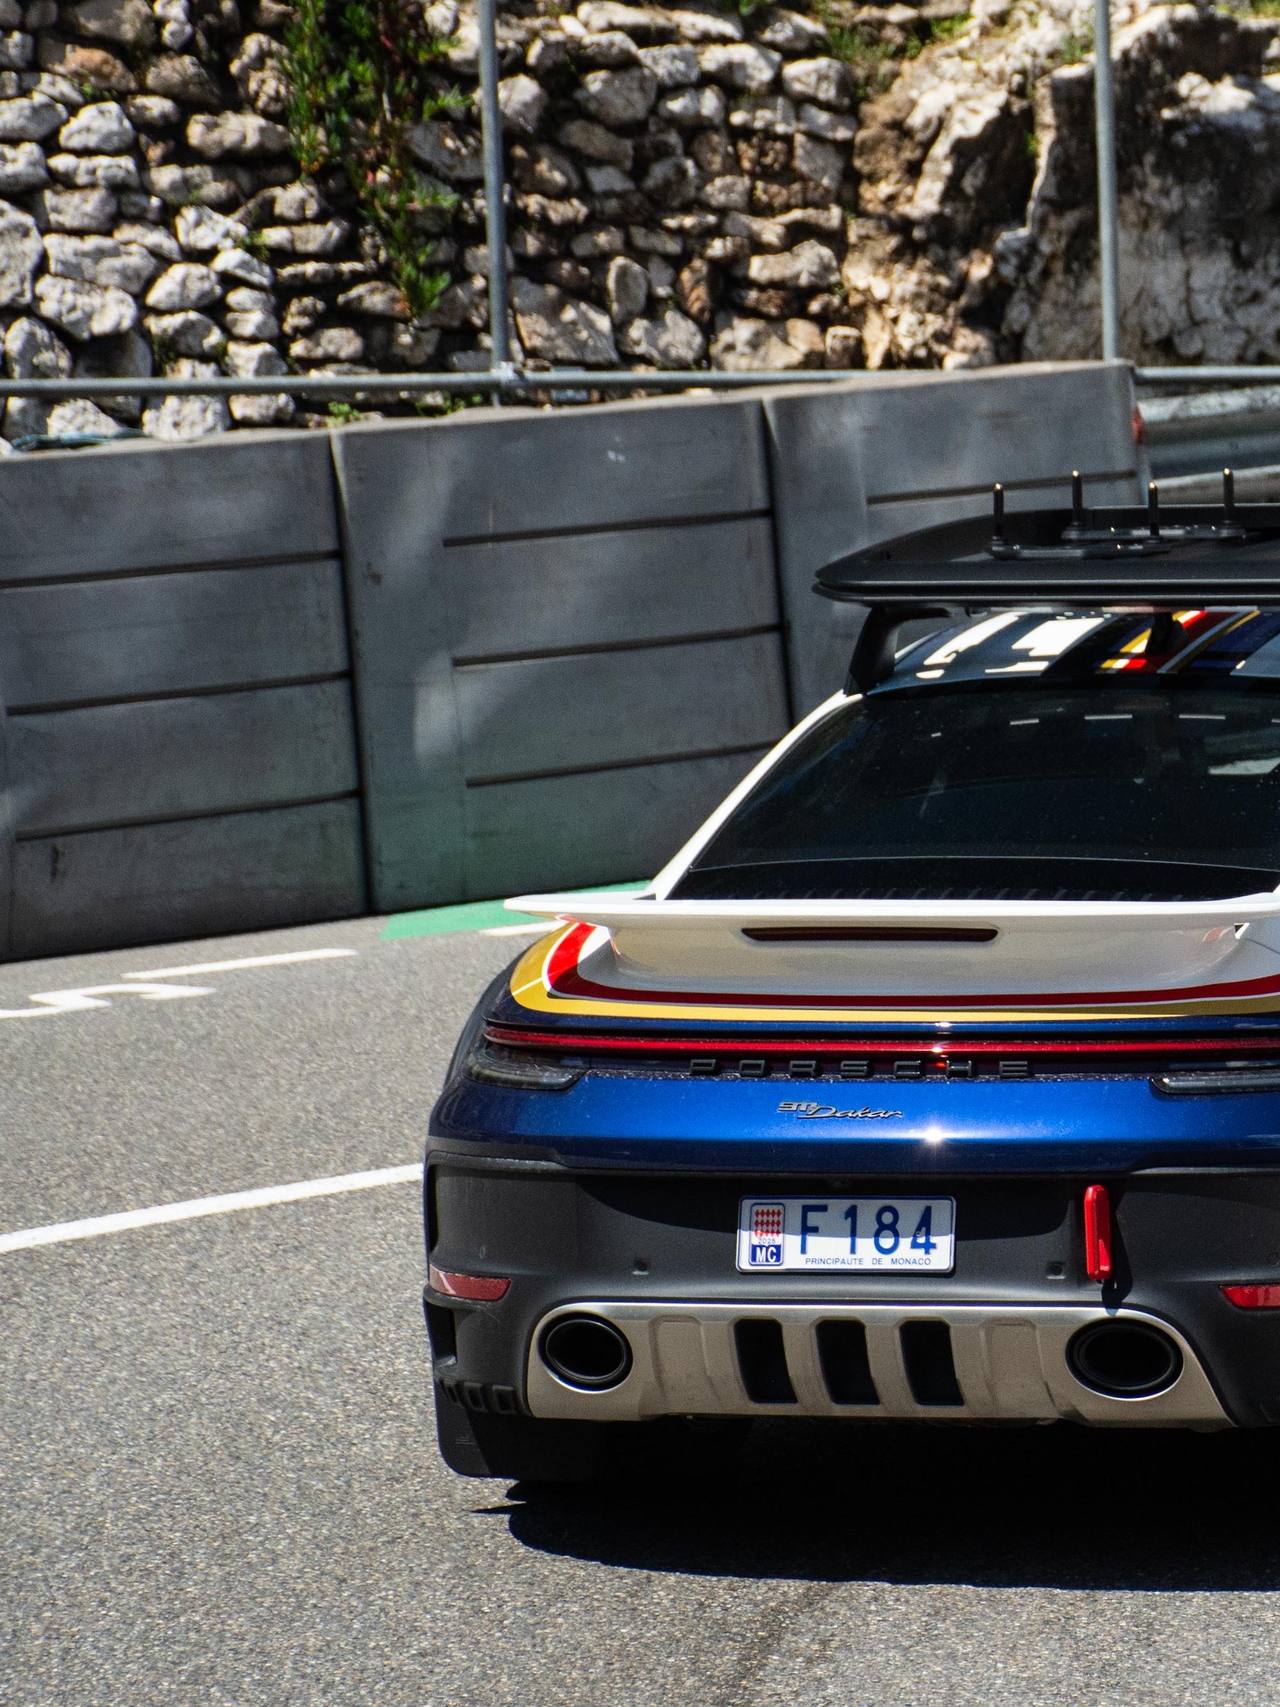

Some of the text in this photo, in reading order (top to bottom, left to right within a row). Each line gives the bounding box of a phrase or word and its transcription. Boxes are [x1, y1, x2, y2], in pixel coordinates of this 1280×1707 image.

[690, 1060, 1030, 1077] PORSCHE
[797, 1106, 903, 1119] Dakar
[800, 1204, 937, 1255] F184
[756, 1246, 777, 1263] MC
[805, 1258, 931, 1266] PRINCIPAUTE DE MONACO
